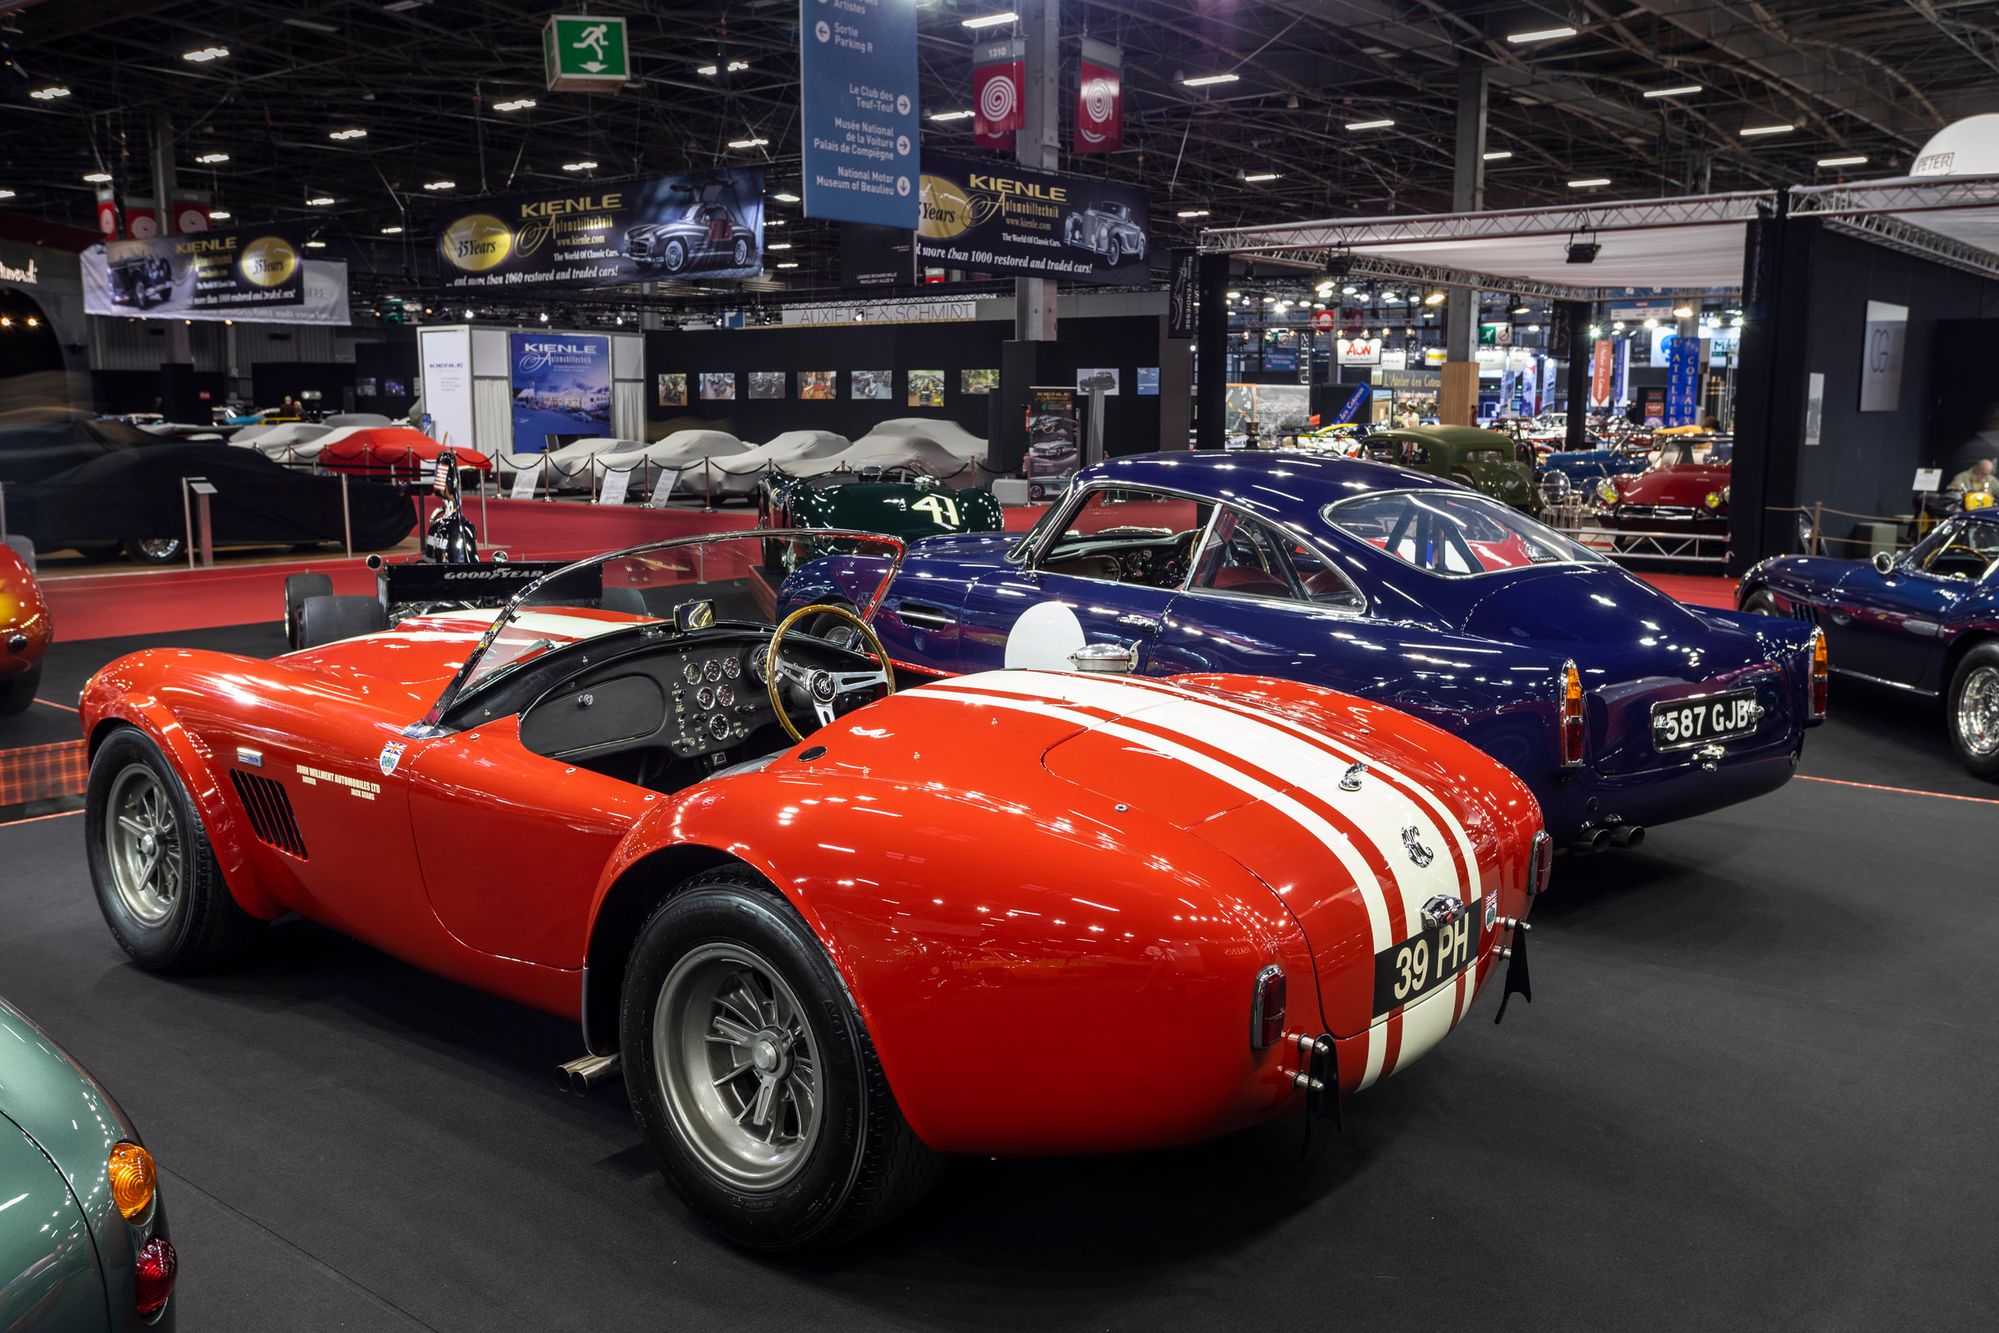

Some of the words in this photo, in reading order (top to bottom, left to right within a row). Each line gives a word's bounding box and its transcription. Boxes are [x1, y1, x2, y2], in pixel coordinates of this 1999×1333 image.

[834, 22, 859, 37] Sortie
[835, 35, 865, 53] Parking
[867, 42, 873, 53] R
[989, 47, 1006, 58] 1310
[849, 83, 859, 94] Le
[861, 86, 878, 98] Club
[880, 90, 893, 101] des
[856, 97, 894, 113] Teuf-Teuf
[834, 117, 860, 131] Musée
[862, 122, 894, 136] National
[846, 131, 856, 142] de
[857, 133, 865, 144] la
[866, 134, 894, 148] Voiture
[814, 138, 839, 151] Palais
[840, 143, 850, 154] de
[851, 145, 894, 160] Compiègne
[838, 166, 870, 180] National
[872, 170, 894, 183] Motor
[816, 175, 850, 190] Museum
[851, 181, 860, 190] of
[861, 182, 894, 195] Beaulieu
[969, 173, 1067, 202] KIENLE
[521, 193, 622, 218] KIENLE
[922, 203, 956, 223] Years
[1005, 216, 1051, 231] www.kienle.com
[176, 237, 237, 254] KIENLE
[468, 240, 496, 256] Years
[1002, 232, 1012, 242] The
[1012, 234, 1027, 243] World
[1033, 236, 1049, 246] Classic
[554, 252, 564, 261] The
[564, 251, 579, 260] World
[587, 250, 605, 259] Classic
[922, 246, 945, 258] more
[948, 247, 968, 261] than
[971, 250, 993, 263] 1000
[994, 252, 1028, 268] restored
[1029, 256, 1045, 269] and
[1047, 258, 1072, 272] traded
[1074, 263, 1093, 274] cars!
[486, 273, 503, 285] than
[524, 269, 554, 283] restored
[556, 267, 570, 280] and
[572, 267, 598, 279] traded
[599, 265, 619, 277] cars!
[895, 303, 973, 320] SCHMIDT
[524, 343, 597, 354] KIENLE
[1684, 356, 1695, 424] COTEAUX
[911, 494, 960, 526] 41
[444, 567, 543, 581] GOODYEAR
[1666, 706, 1706, 741] 587
[1712, 699, 1749, 732] GJB
[1394, 938, 1429, 1000] 39
[1436, 912, 1469, 979] PH
